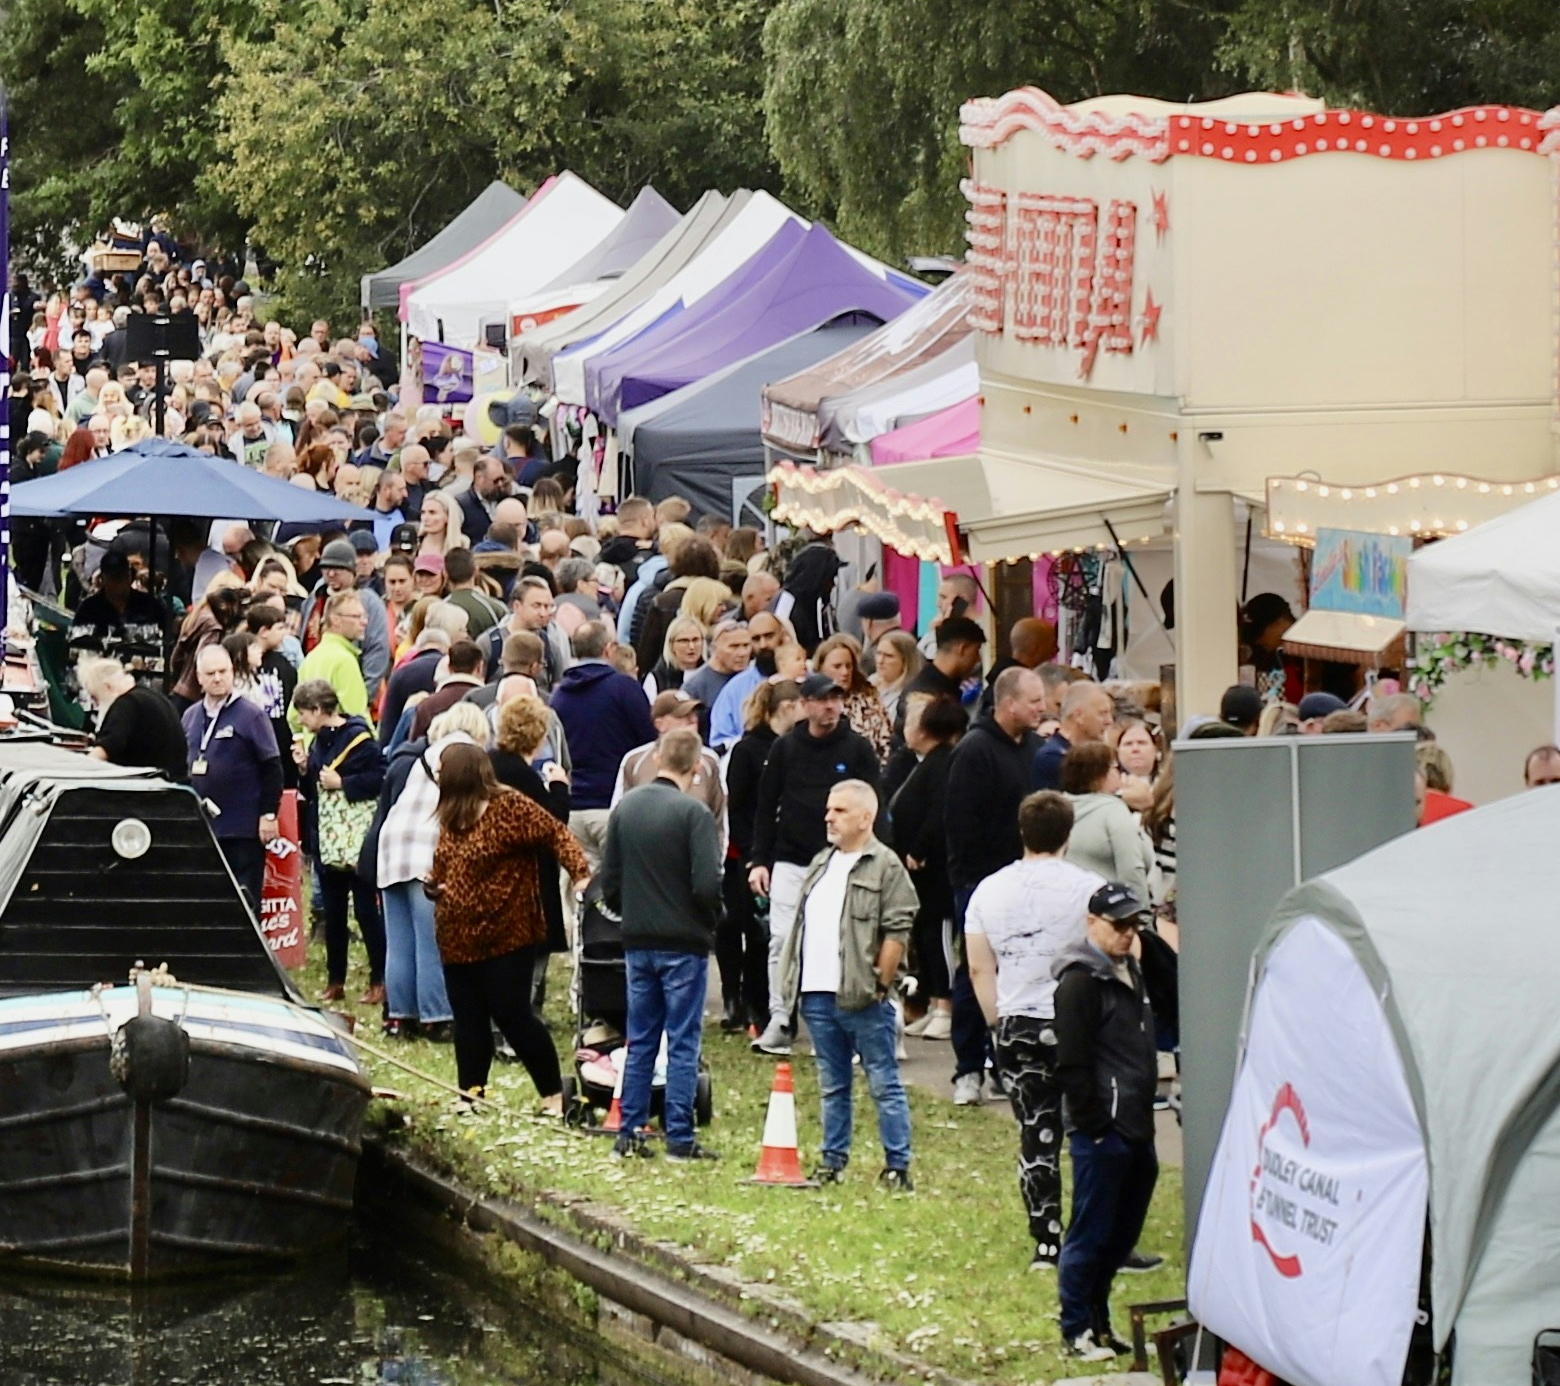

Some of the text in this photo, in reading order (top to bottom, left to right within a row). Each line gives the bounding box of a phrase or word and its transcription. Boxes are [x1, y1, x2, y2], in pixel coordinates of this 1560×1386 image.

[1264, 1147, 1339, 1206] DUDLEY CANAL
[1300, 1207, 1339, 1246] TRUST
